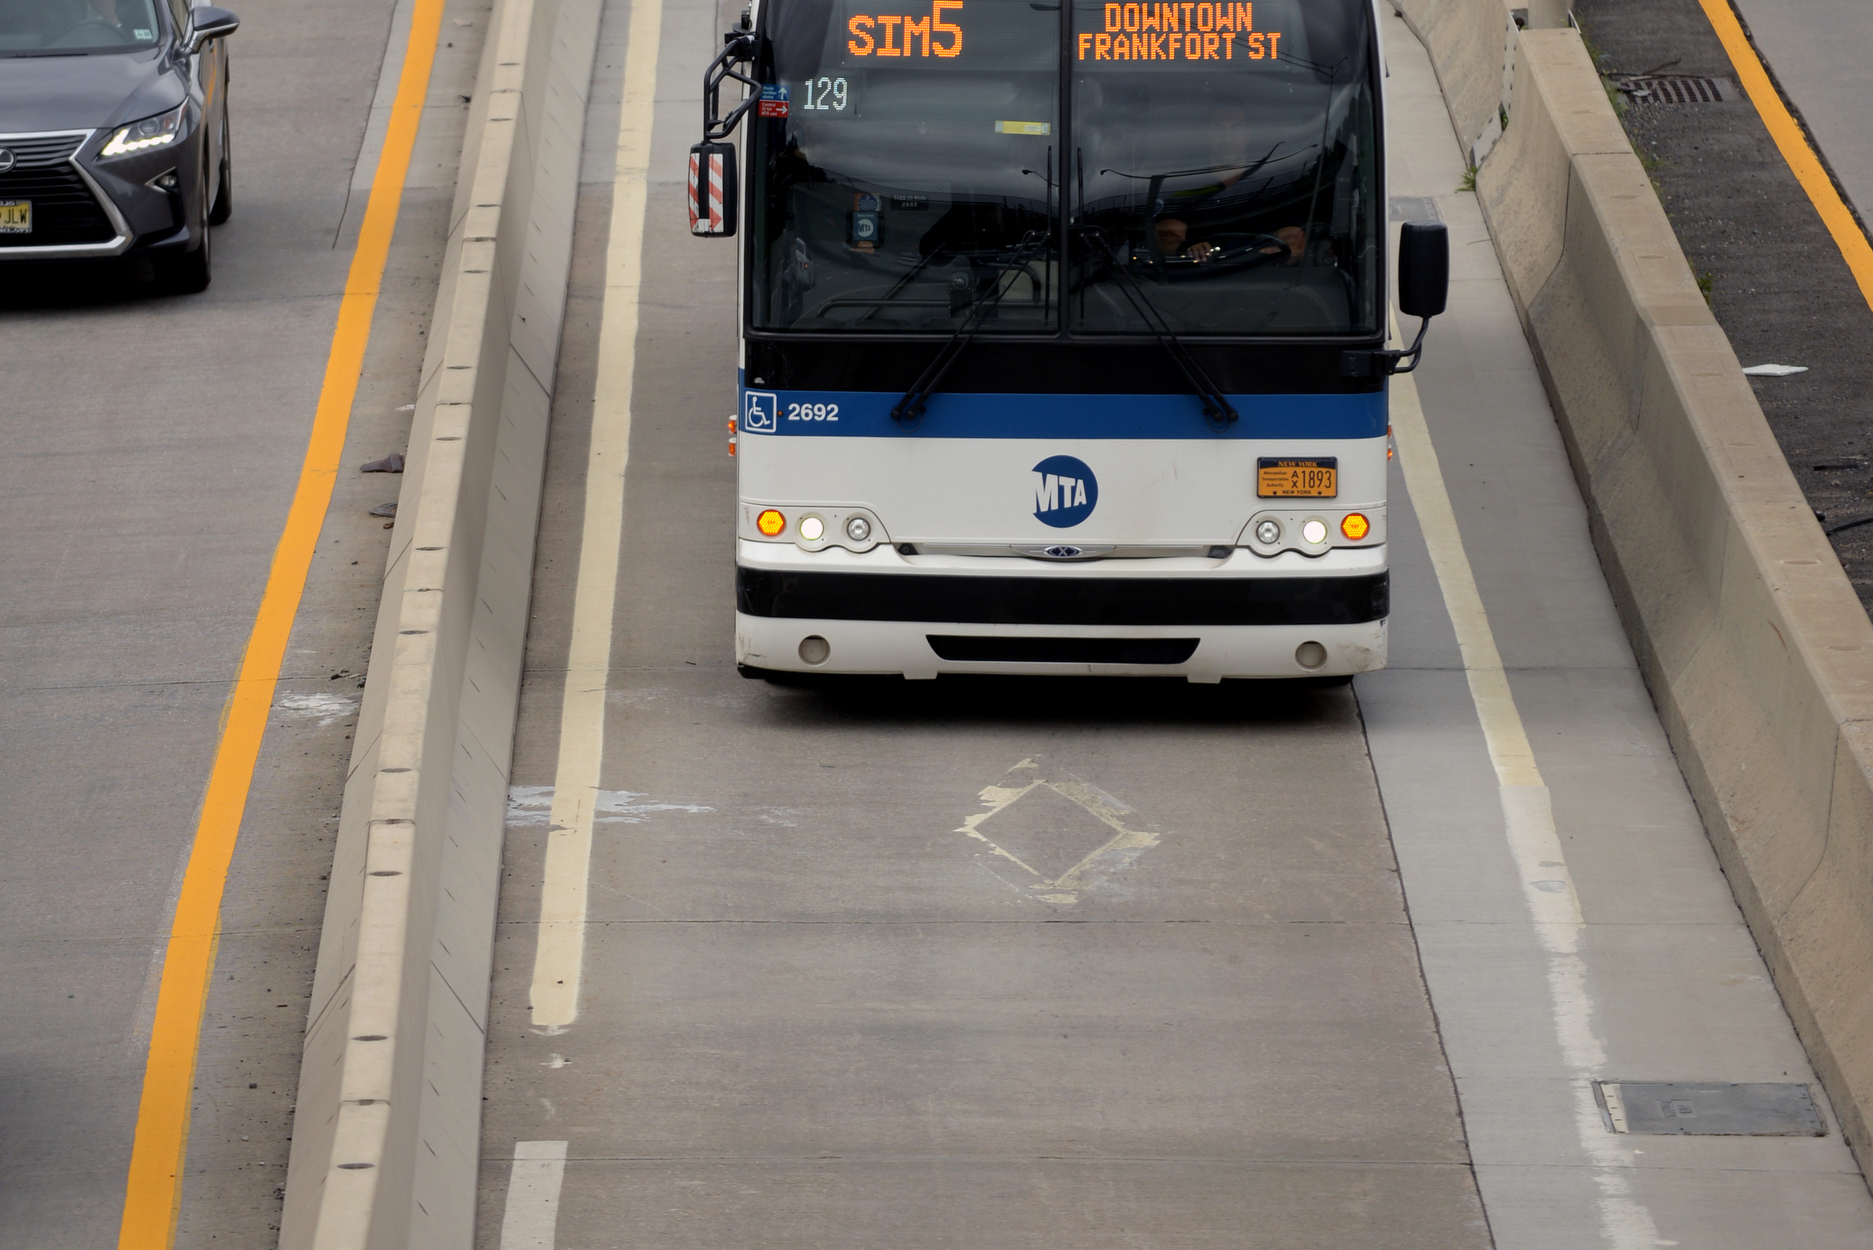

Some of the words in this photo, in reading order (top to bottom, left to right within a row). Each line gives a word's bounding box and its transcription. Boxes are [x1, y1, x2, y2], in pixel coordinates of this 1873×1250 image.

[848, 0, 963, 58] SIM5
[1104, 2, 1253, 32] DOWNTOWN
[1078, 32, 1236, 61] FRANKFORT
[1248, 32, 1282, 60] ST
[803, 77, 848, 111] 129
[4, 208, 28, 224] JLW
[787, 403, 839, 421] 2692
[1031, 470, 1087, 513] MTA
[1301, 470, 1332, 488] 1893
